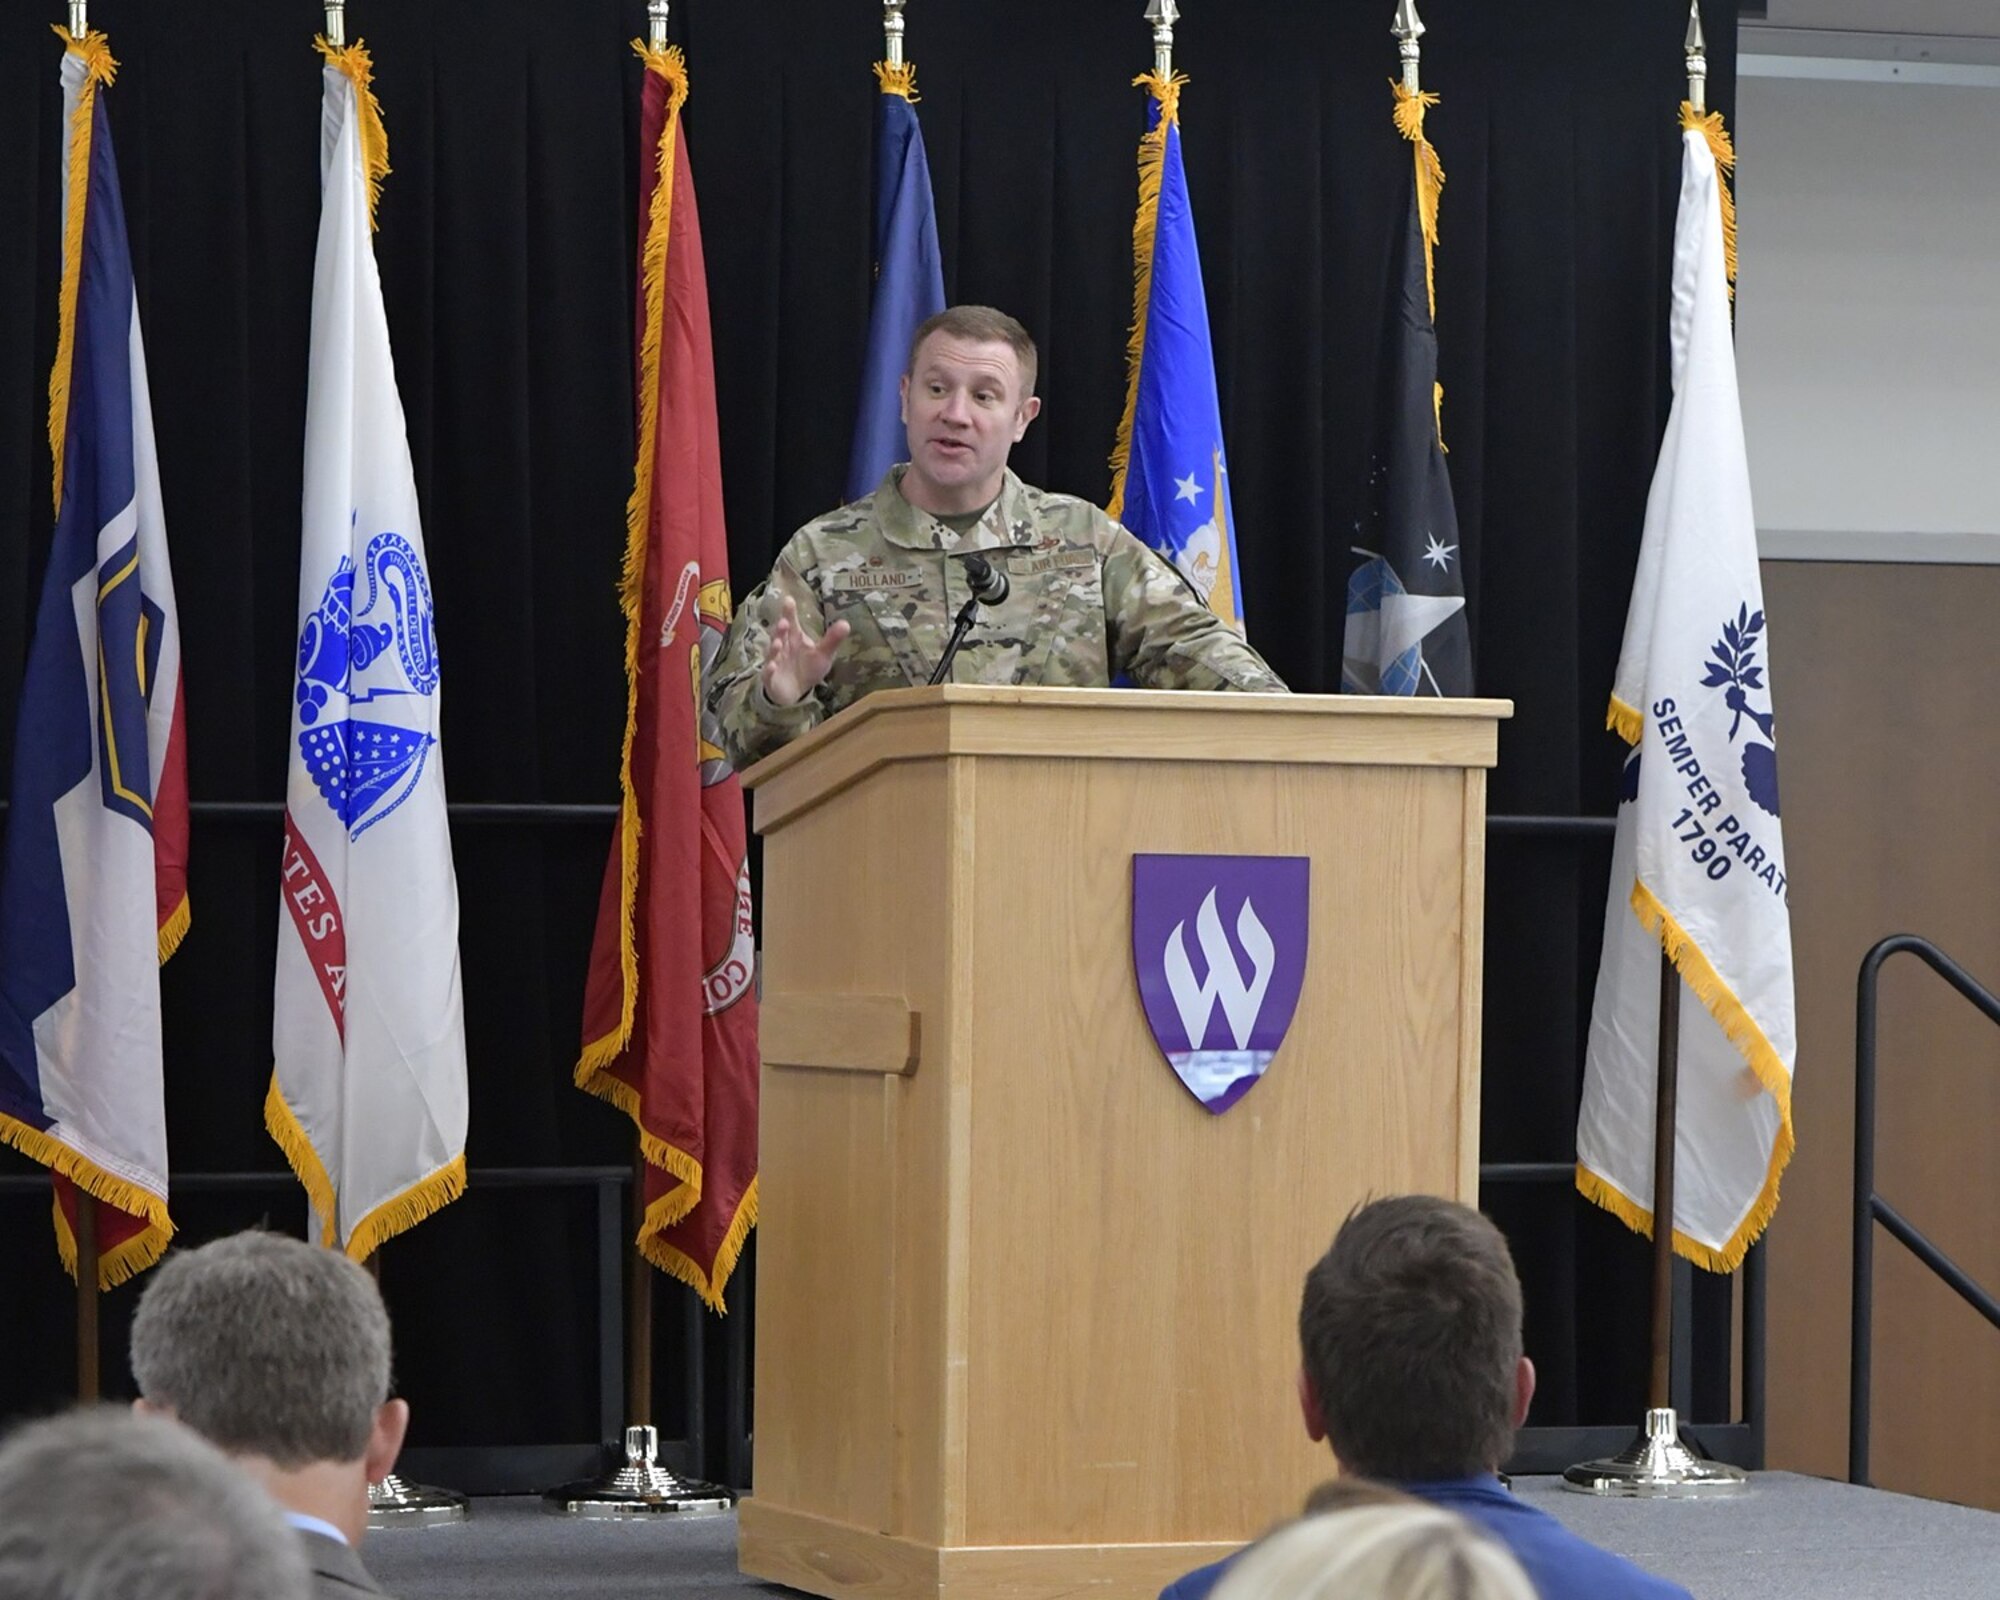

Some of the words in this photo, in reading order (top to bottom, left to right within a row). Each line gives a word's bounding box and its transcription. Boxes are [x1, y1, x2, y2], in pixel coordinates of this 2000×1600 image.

[389, 553, 408, 573] THIS
[408, 614, 426, 674] DEFEND
[849, 573, 906, 588] HOLLAND
[1652, 698, 1722, 816] SEMPER
[1672, 808, 1732, 881] 1790
[324, 962, 346, 1011] A
